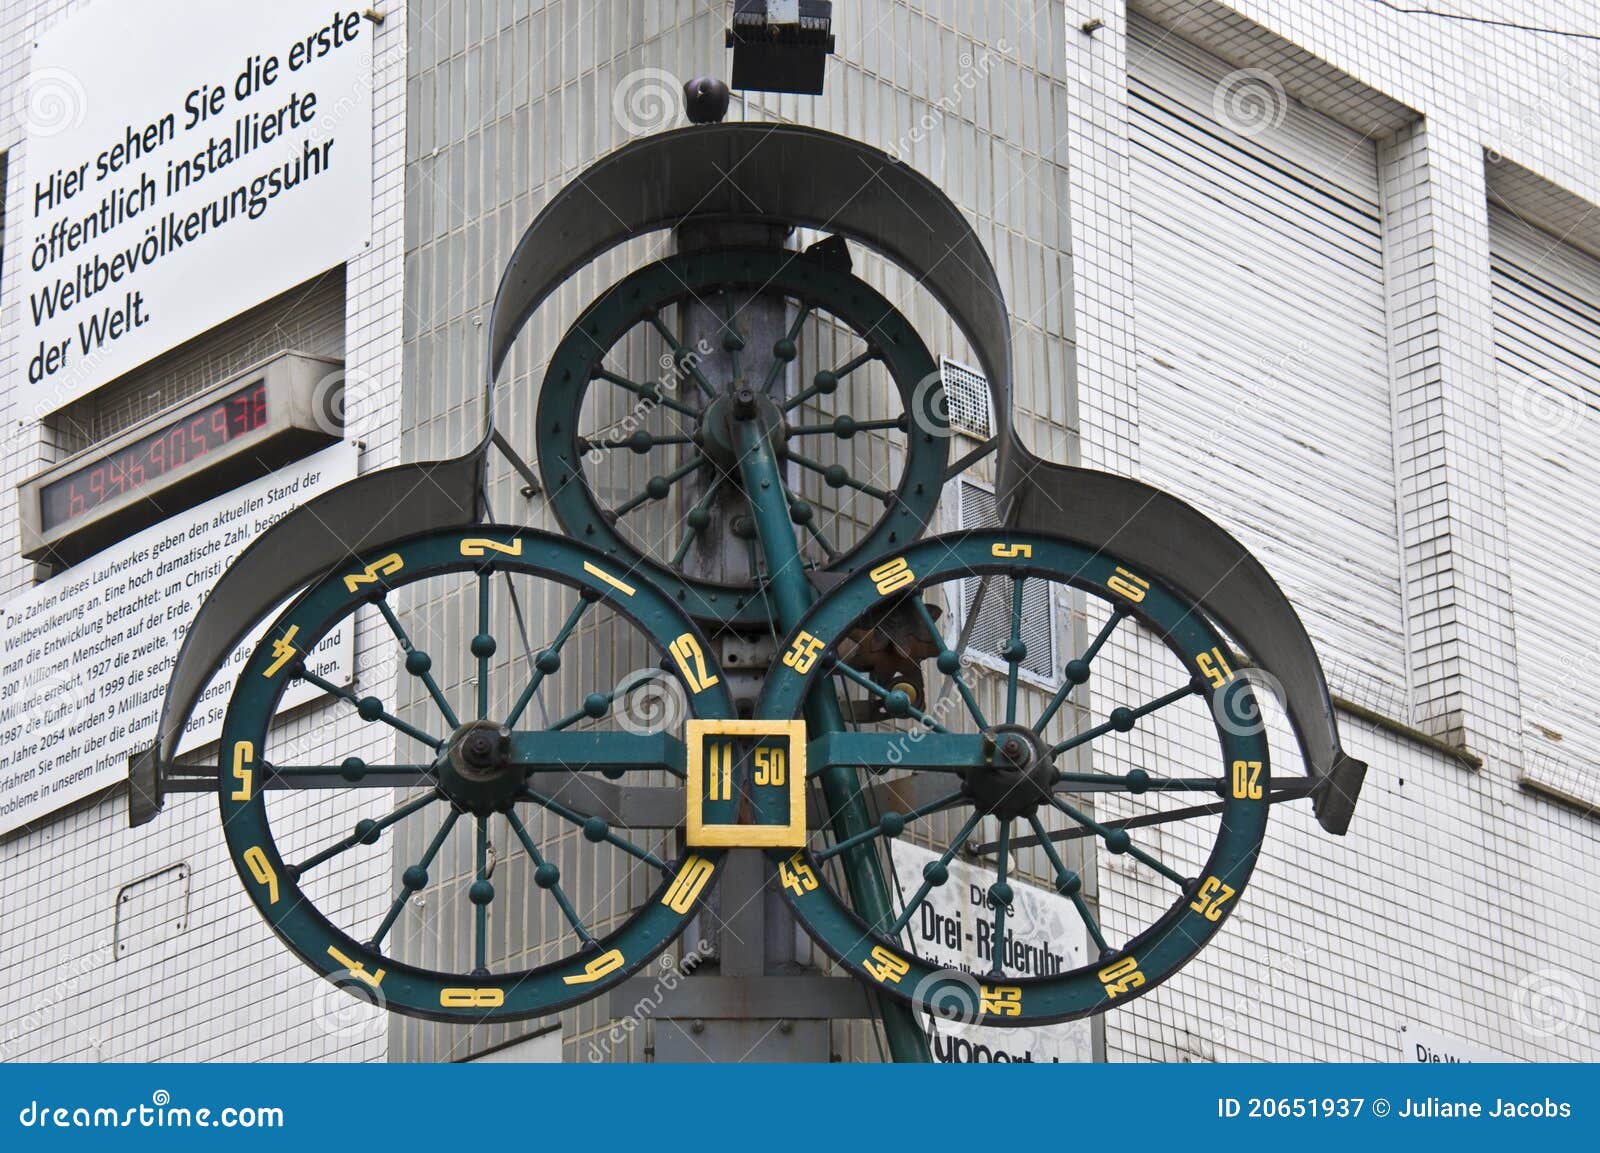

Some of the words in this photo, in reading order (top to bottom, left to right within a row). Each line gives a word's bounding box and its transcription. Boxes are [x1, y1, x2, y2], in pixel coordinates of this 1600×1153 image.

[34, 159, 89, 217] Hier
[97, 112, 175, 181] sehen
[184, 86, 225, 130] Sie
[234, 54, 279, 101] die
[288, 10, 361, 72] erste
[31, 173, 156, 272] öffentlich
[166, 90, 317, 197] installierte
[30, 138, 334, 327] Weltbevölkerungsuhr
[28, 337, 71, 384] der
[78, 290, 150, 356] Welt.
[7, 614, 22, 629] Die
[25, 596, 56, 620] Zahlen
[60, 579, 89, 601] dieses
[93, 549, 149, 584] Laufwerkes
[152, 532, 185, 560] geben
[189, 522, 209, 539] den
[213, 498, 263, 528] aktuellen
[267, 477, 299, 504] Stand
[303, 472, 321, 488] der
[344, 553, 404, 593] 3
[460, 538, 522, 556] 2
[991, 542, 1032, 559] 5
[5, 604, 84, 652] Weltbevölkerung
[87, 597, 101, 611] an.
[105, 584, 125, 602] Eine
[129, 568, 153, 590] hoch
[156, 540, 221, 577] dramatische
[224, 524, 250, 547] Zahl,
[583, 561, 637, 596] 1
[870, 557, 915, 596] 00
[1106, 566, 1150, 603] 10
[3, 658, 23, 676] man
[26, 649, 41, 664] die
[44, 618, 103, 655] Entwicklung
[107, 589, 161, 624] betrachtet:
[165, 581, 181, 597] um
[186, 560, 221, 587] Christi
[1, 680, 19, 700] 300
[72, 632, 123, 665] Menschen
[127, 618, 143, 638] auf
[147, 613, 163, 629] der
[167, 600, 192, 620] Erde.
[44, 673, 83, 701] erreicht,
[87, 658, 111, 680] 1927
[114, 652, 129, 668] die
[132, 636, 168, 660] zweite,
[262, 624, 299, 679] 4
[668, 632, 719, 694] 12
[783, 630, 826, 674] 55
[1195, 646, 1235, 690] 15
[0, 725, 22, 746] 1987
[26, 718, 41, 734] die
[44, 703, 73, 725] fünfte
[77, 689, 95, 710] und
[99, 676, 125, 698] 1999
[128, 670, 144, 686] die
[11, 744, 37, 764] Jahre
[40, 728, 65, 751] 2054
[69, 712, 105, 737] werden
[108, 705, 115, 719] 9
[235, 647, 252, 663] die
[39, 760, 53, 775] Sie
[56, 746, 81, 767] mehr
[84, 735, 107, 754] über
[109, 726, 125, 742] die
[128, 709, 158, 734] damit
[319, 629, 340, 651] und
[41, 785, 49, 797] in
[52, 766, 93, 792] unserem
[186, 716, 205, 733] den
[208, 708, 225, 723] Sie
[231, 740, 254, 801] 5
[709, 742, 731, 801] 11
[754, 747, 785, 786] 50
[1232, 760, 1264, 801] 20
[661, 854, 714, 915] 10
[779, 850, 819, 897] 45
[1190, 876, 1236, 922] 25
[327, 945, 386, 988] 7
[862, 945, 911, 984] 40
[1098, 956, 1146, 999] 30
[440, 987, 504, 1008] 8
[980, 984, 1022, 1016] 35
